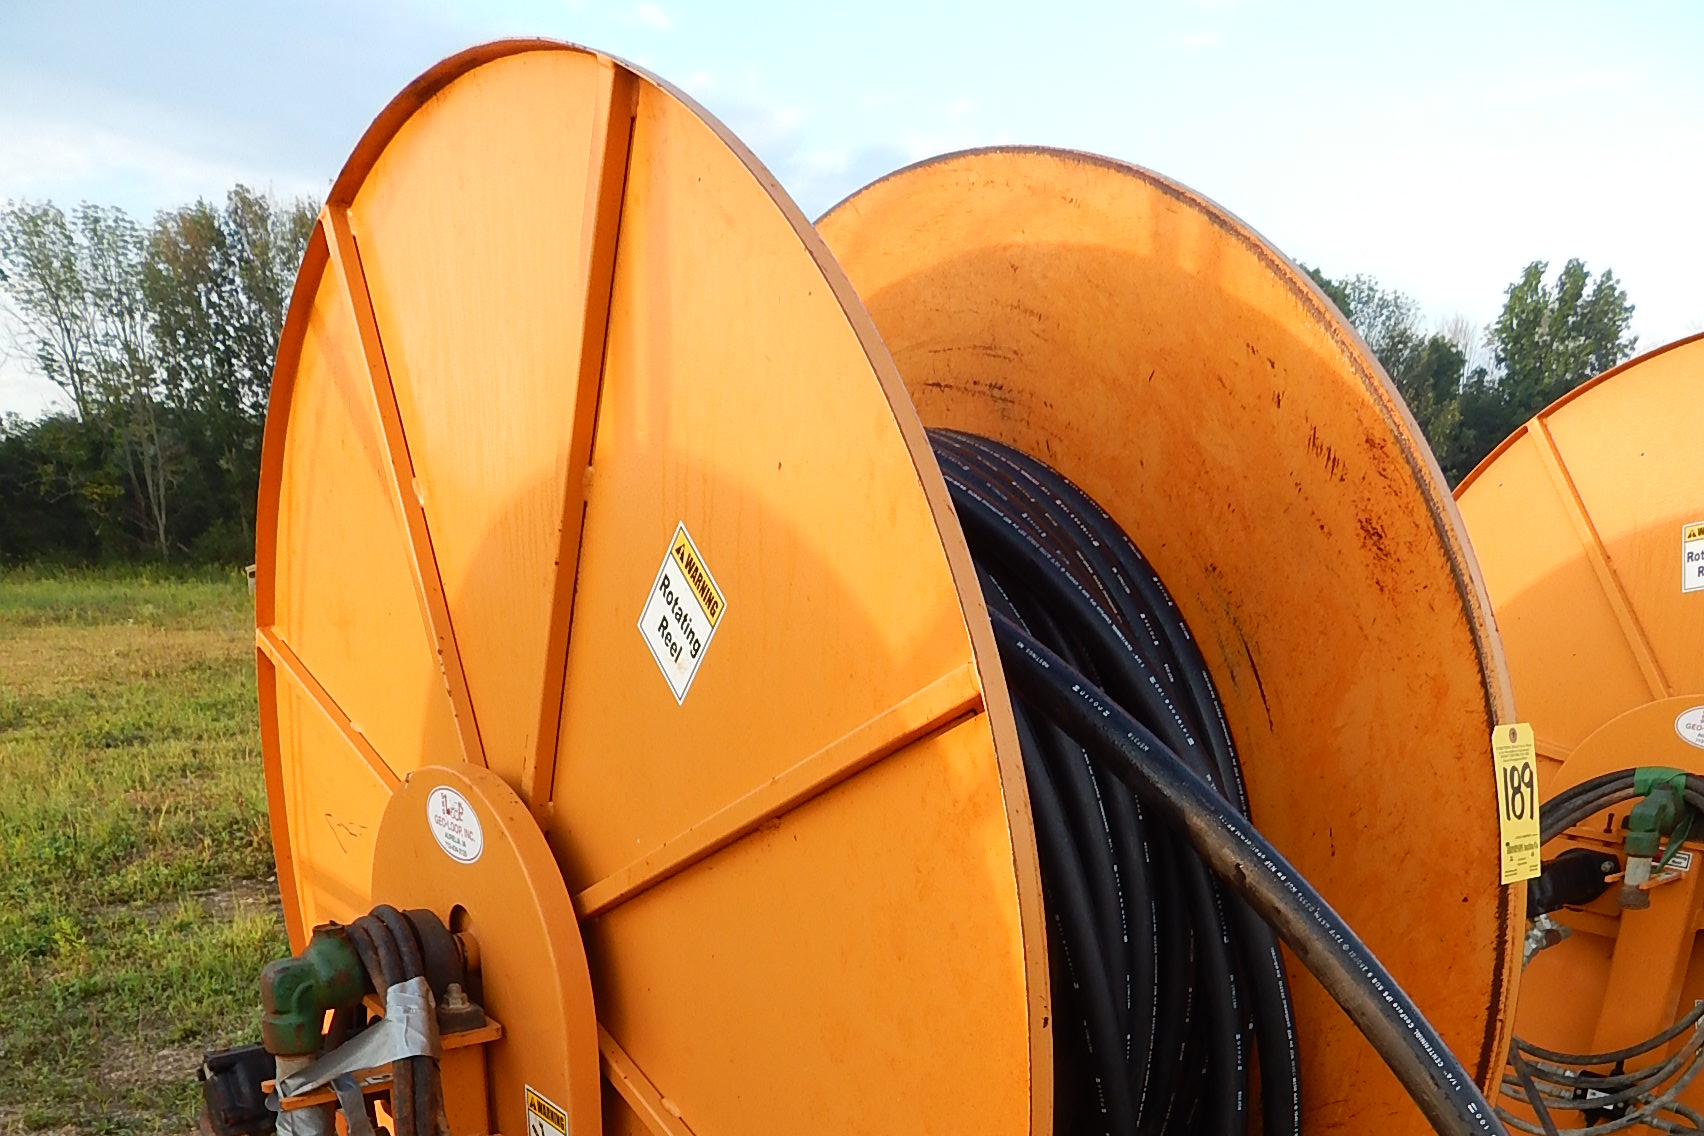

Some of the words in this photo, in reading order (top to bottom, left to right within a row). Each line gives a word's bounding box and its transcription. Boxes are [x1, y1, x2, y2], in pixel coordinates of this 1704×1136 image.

[684, 553, 719, 618] WARNING
[658, 615, 683, 663] Reel
[659, 573, 701, 659] Rotating
[1503, 761, 1534, 821] 189
[1413, 1028, 1444, 1067] CENTENNIAL
